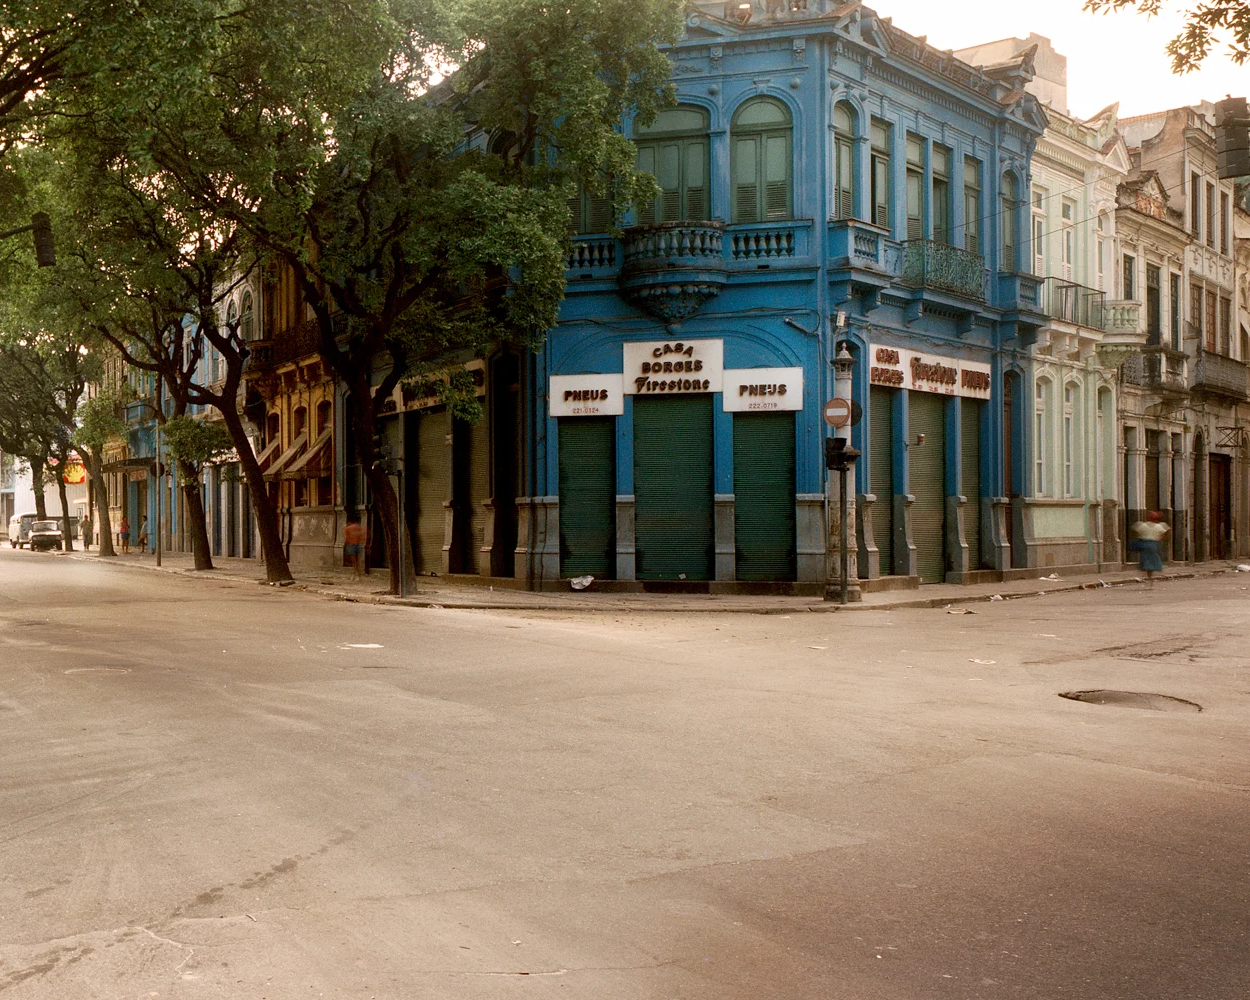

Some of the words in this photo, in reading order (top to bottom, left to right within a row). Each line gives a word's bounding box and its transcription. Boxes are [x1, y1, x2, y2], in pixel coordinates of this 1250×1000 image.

[653, 342, 694, 358] CASA
[876, 348, 900, 365] CASA
[642, 359, 703, 374] BORGES
[871, 366, 904, 385] BORGES
[961, 369, 991, 391] PNEUS
[635, 377, 710, 393] Firestone
[739, 383, 787, 397] PNEUS
[564, 389, 609, 402] PNEUS
